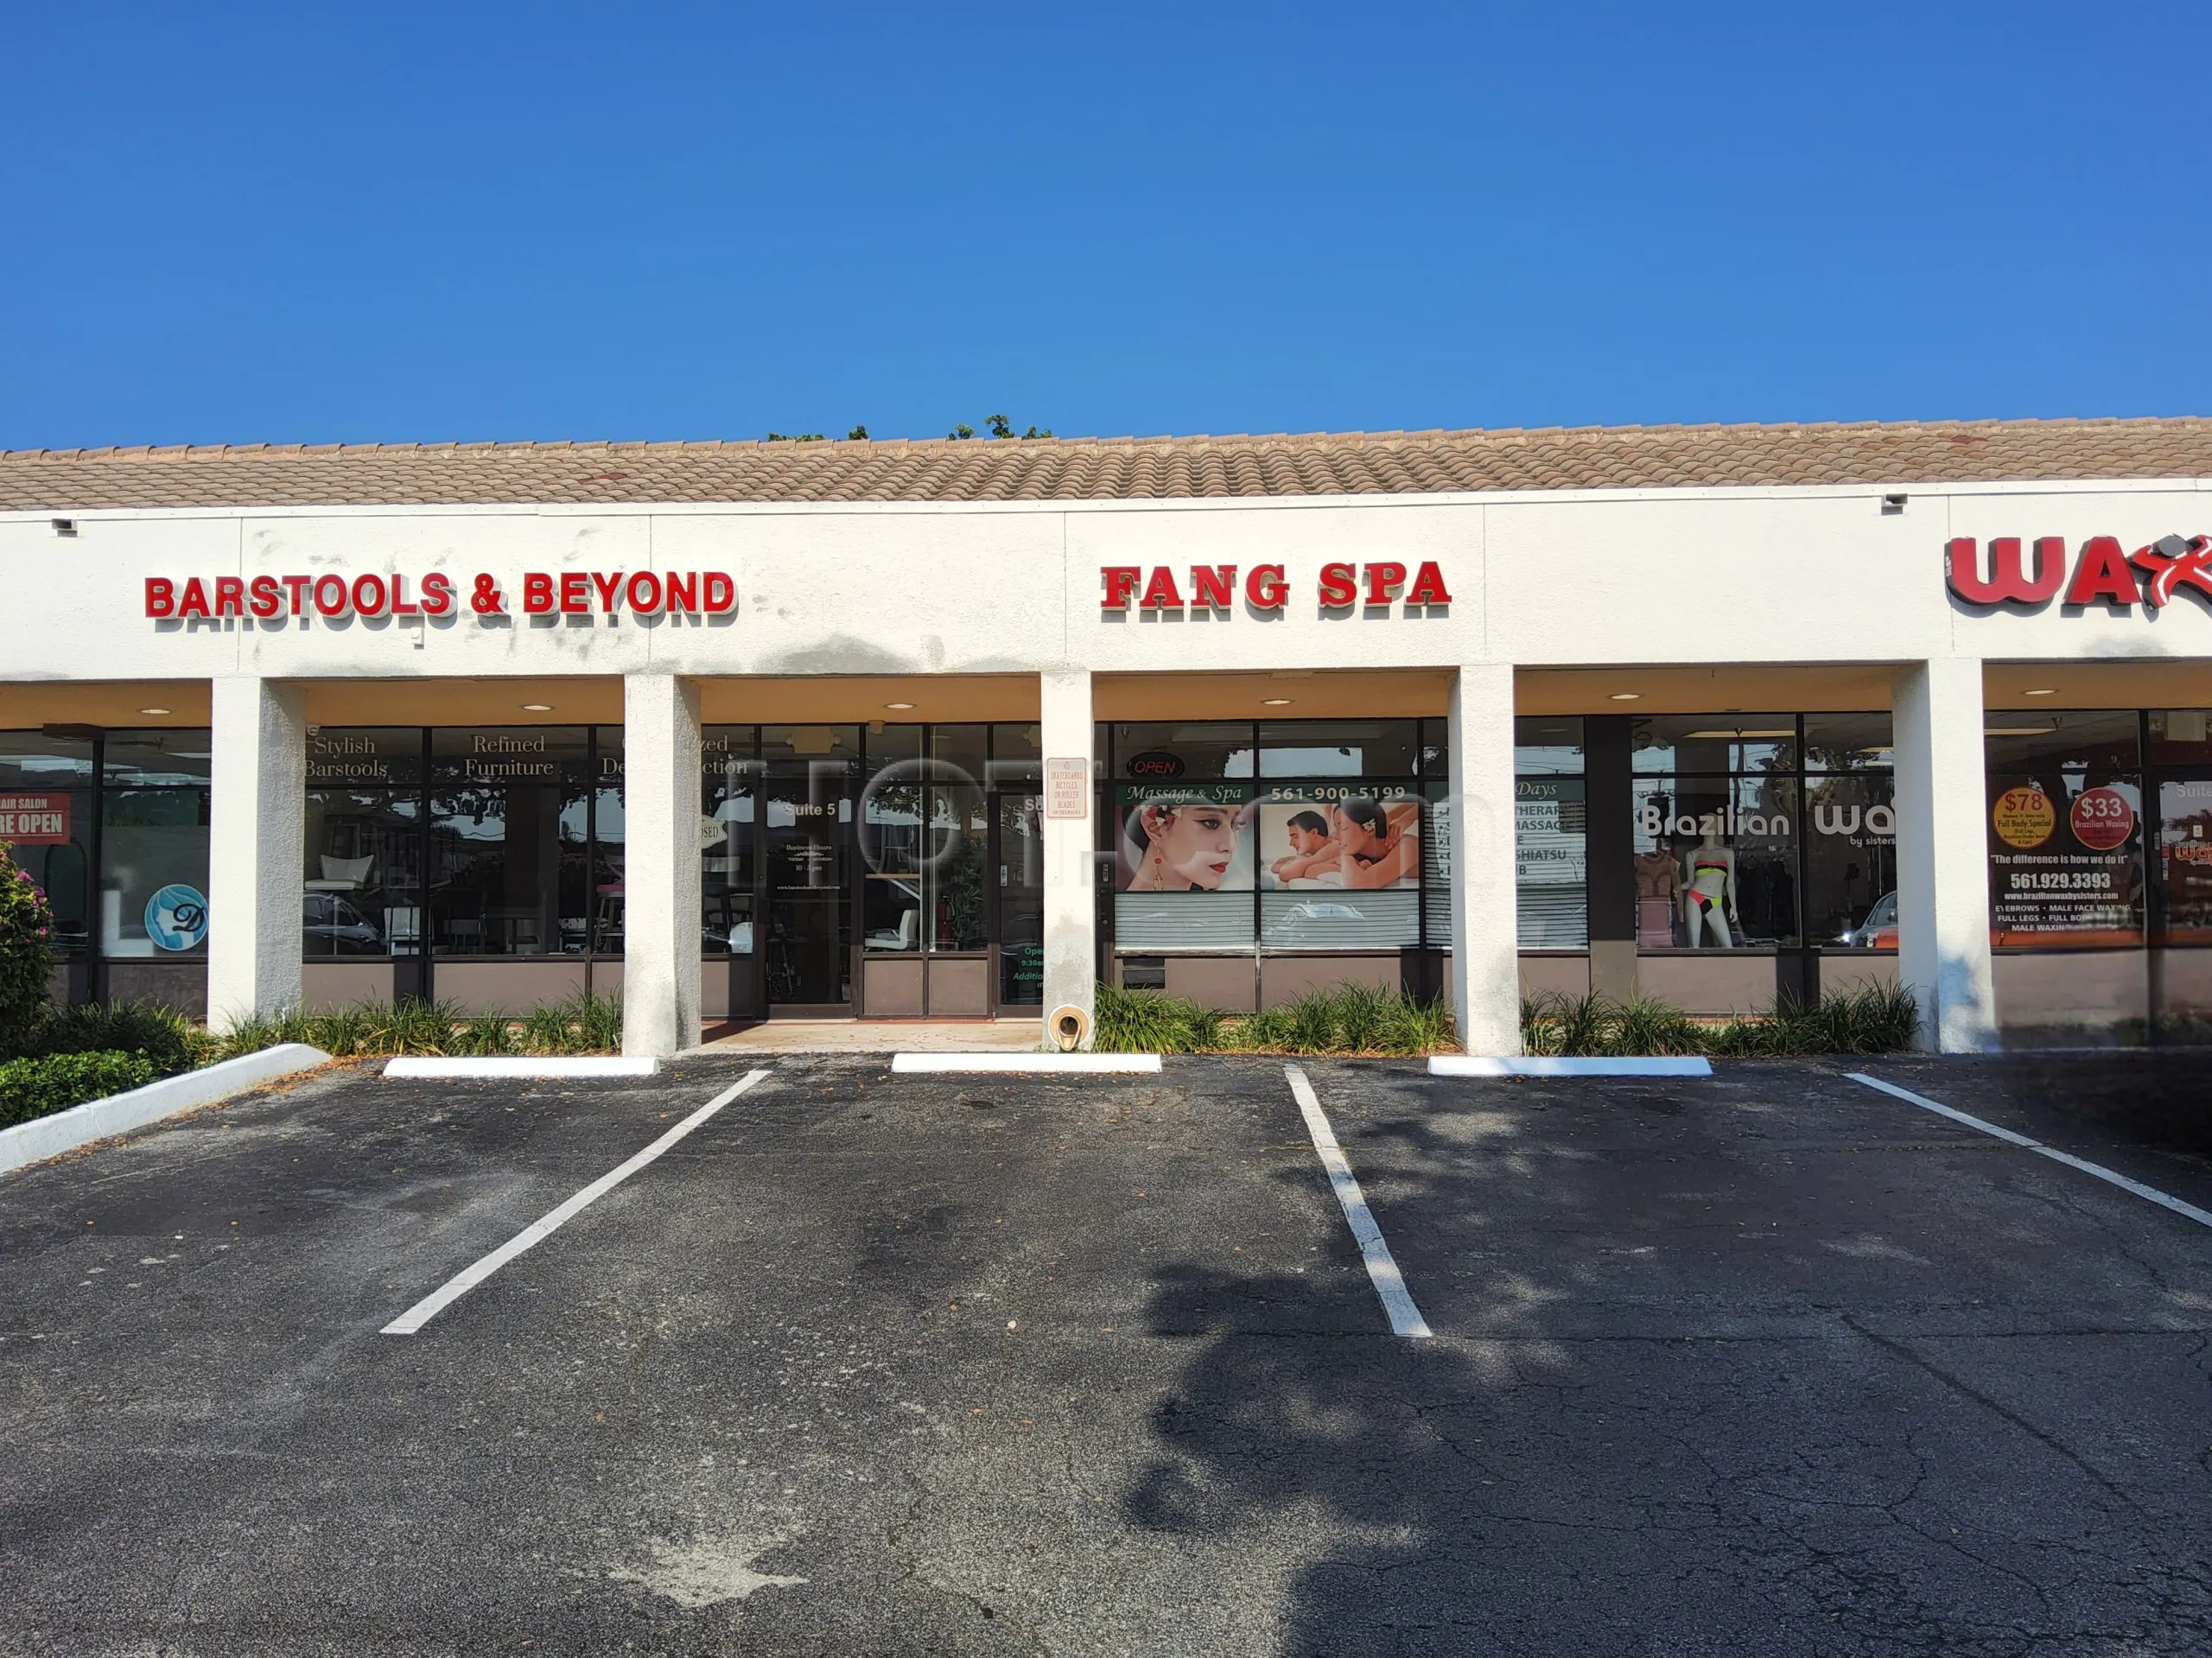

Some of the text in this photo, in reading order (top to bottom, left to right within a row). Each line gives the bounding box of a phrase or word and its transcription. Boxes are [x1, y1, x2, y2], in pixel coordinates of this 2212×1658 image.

[1100, 561, 1452, 610] FANG SPA
[144, 570, 738, 619] BARSTOOLS & BEYOND
[315, 737, 375, 759] Stylish
[473, 735, 545, 753] Refined
[305, 759, 388, 777] Barstools
[464, 759, 554, 776] Furniture
[1134, 761, 1176, 774] OPEN
[1127, 785, 1243, 804] Massage & Spa
[1271, 786, 1406, 801] 561-900-5199
[1515, 782, 1558, 800] Days
[0, 798, 48, 809] AIR SALON
[785, 804, 836, 816] Suite 5
[1058, 800, 1076, 809] BLADES
[2005, 793, 2044, 812] $78
[2081, 797, 2122, 819] $33
[18, 814, 62, 833] OPEN
[1641, 798, 1896, 835] Brazilian wa
[2029, 819, 2051, 829] Special
[2105, 819, 2130, 829] Waxing
[1850, 835, 1896, 847] by sisters
[2012, 854, 2058, 864] difference
[2060, 854, 2069, 864] is
[2070, 854, 2088, 864] how
[2090, 855, 2102, 864] we
[2104, 854, 2116, 864] do
[2011, 873, 2111, 889] 561.929.3393
[2004, 892, 2119, 900] www.brazilianwaxbysisters.com
[1013, 972, 1044, 981] Additio
